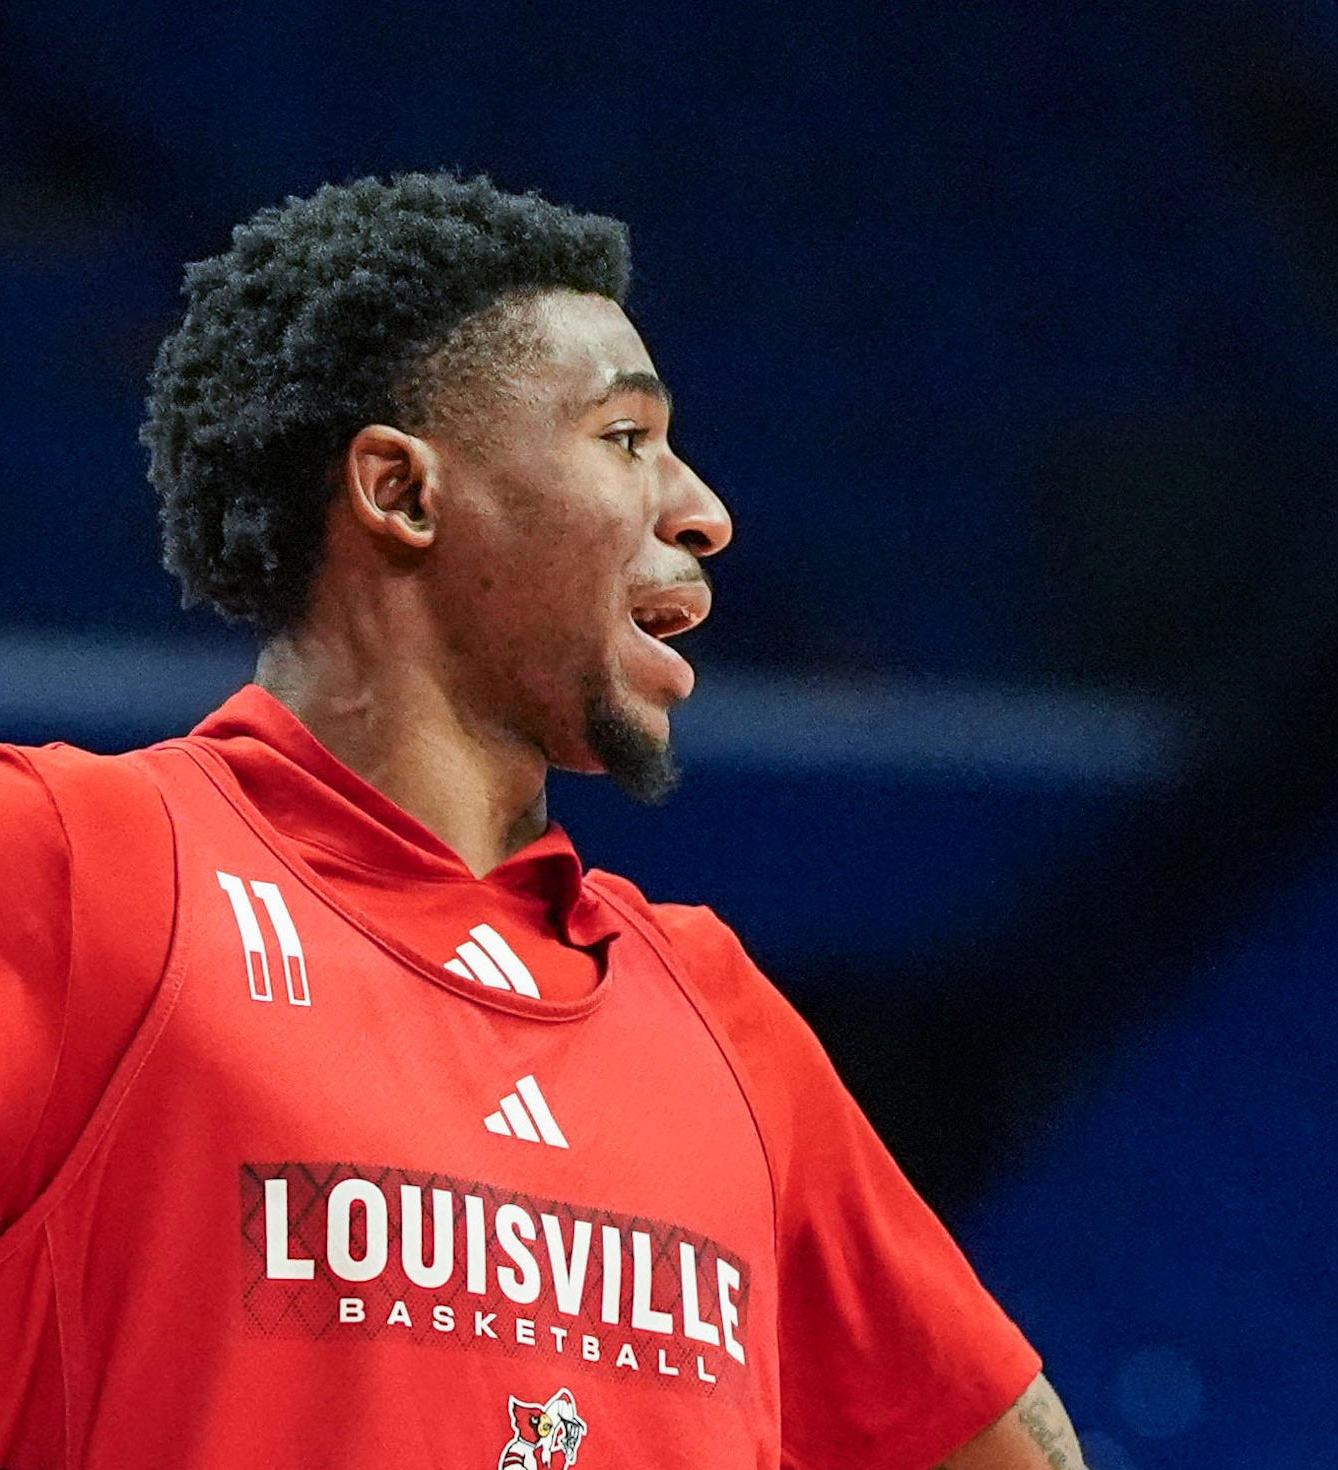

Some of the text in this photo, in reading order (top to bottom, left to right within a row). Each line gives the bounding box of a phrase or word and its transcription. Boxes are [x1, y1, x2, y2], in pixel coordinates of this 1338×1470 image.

[216, 871, 311, 1006] 11
[264, 1178, 746, 1366] LOUISVILLE
[338, 1297, 717, 1384] BASKETBALL
